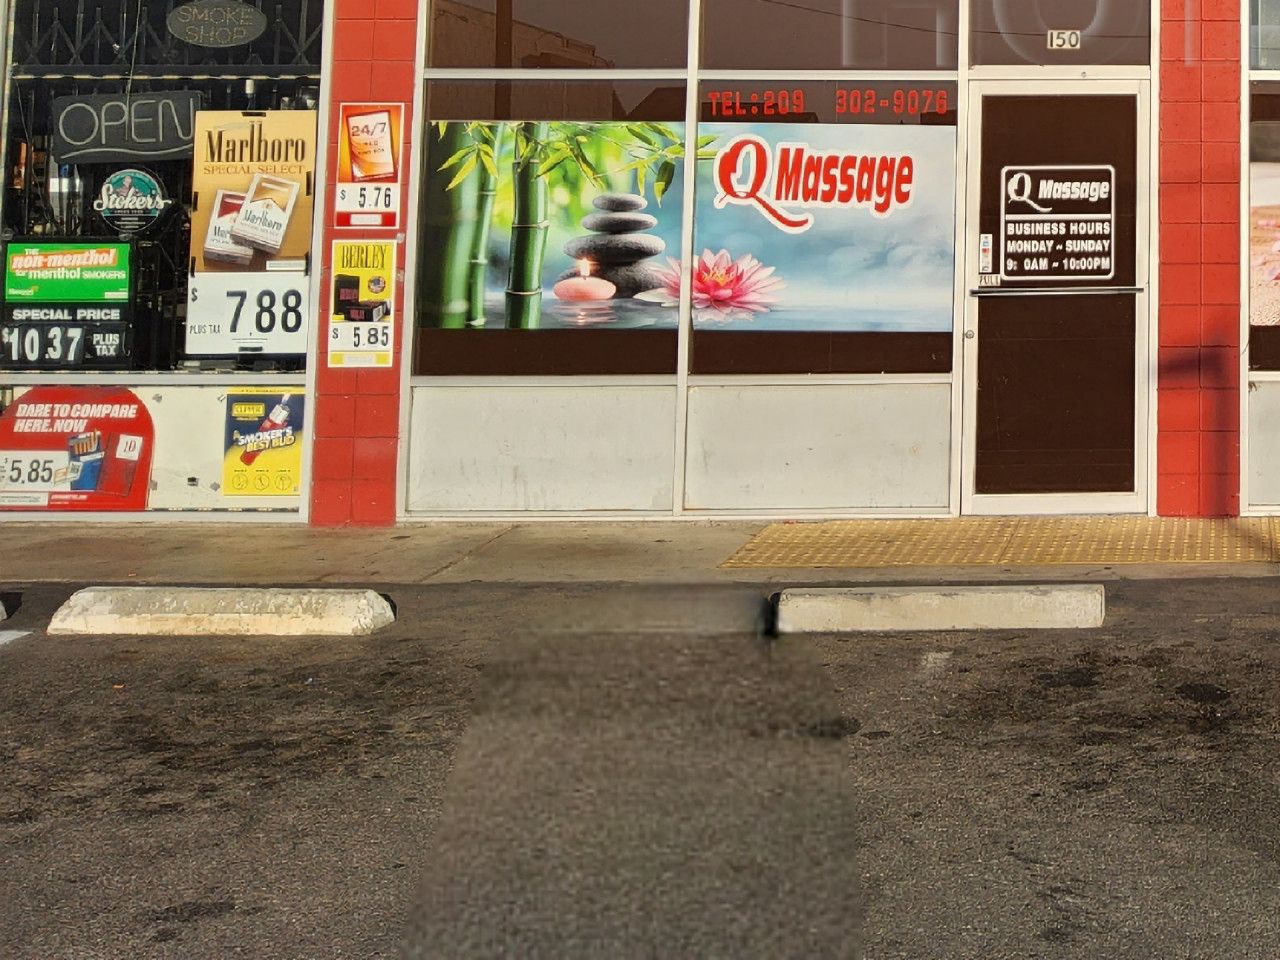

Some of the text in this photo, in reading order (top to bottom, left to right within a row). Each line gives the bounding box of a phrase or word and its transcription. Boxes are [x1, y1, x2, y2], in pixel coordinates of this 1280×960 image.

[176, 5, 254, 25] SMOKE
[185, 25, 247, 44] SHOP
[1049, 31, 1080, 48] 150
[835, 89, 949, 116] 302-9076
[58, 98, 195, 146] OPEN
[351, 122, 387, 137] 24/7
[204, 120, 307, 164] Marlboro
[203, 164, 306, 175] SPECIAL SELECT
[718, 138, 914, 228] Q Massage
[1007, 172, 1110, 213] Q Massage
[340, 186, 392, 208] $ 5.76
[1006, 221, 1111, 235] BUSINESS HOURS
[1006, 239, 1054, 253] MONDAY
[1065, 239, 1111, 253] SUNDAY
[11, 247, 117, 269] non-menthol
[340, 244, 387, 269] BERLEY
[1063, 256, 1111, 271] 10:00PM
[27, 267, 81, 280] menthol
[82, 270, 127, 280] SMOKERS
[12, 308, 121, 320] SPECIAL PRICE
[191, 287, 303, 336] $ 7.88
[92, 333, 120, 345] PLUS
[189, 324, 207, 335] PLUS
[332, 325, 389, 348] $ 5.85
[95, 345, 117, 356] TAX
[15, 403, 138, 418] DARE TO COMPARE
[238, 426, 293, 445] SMOKER'S
[246, 435, 296, 453] BEST BUD
[9, 459, 54, 484] 5.85
